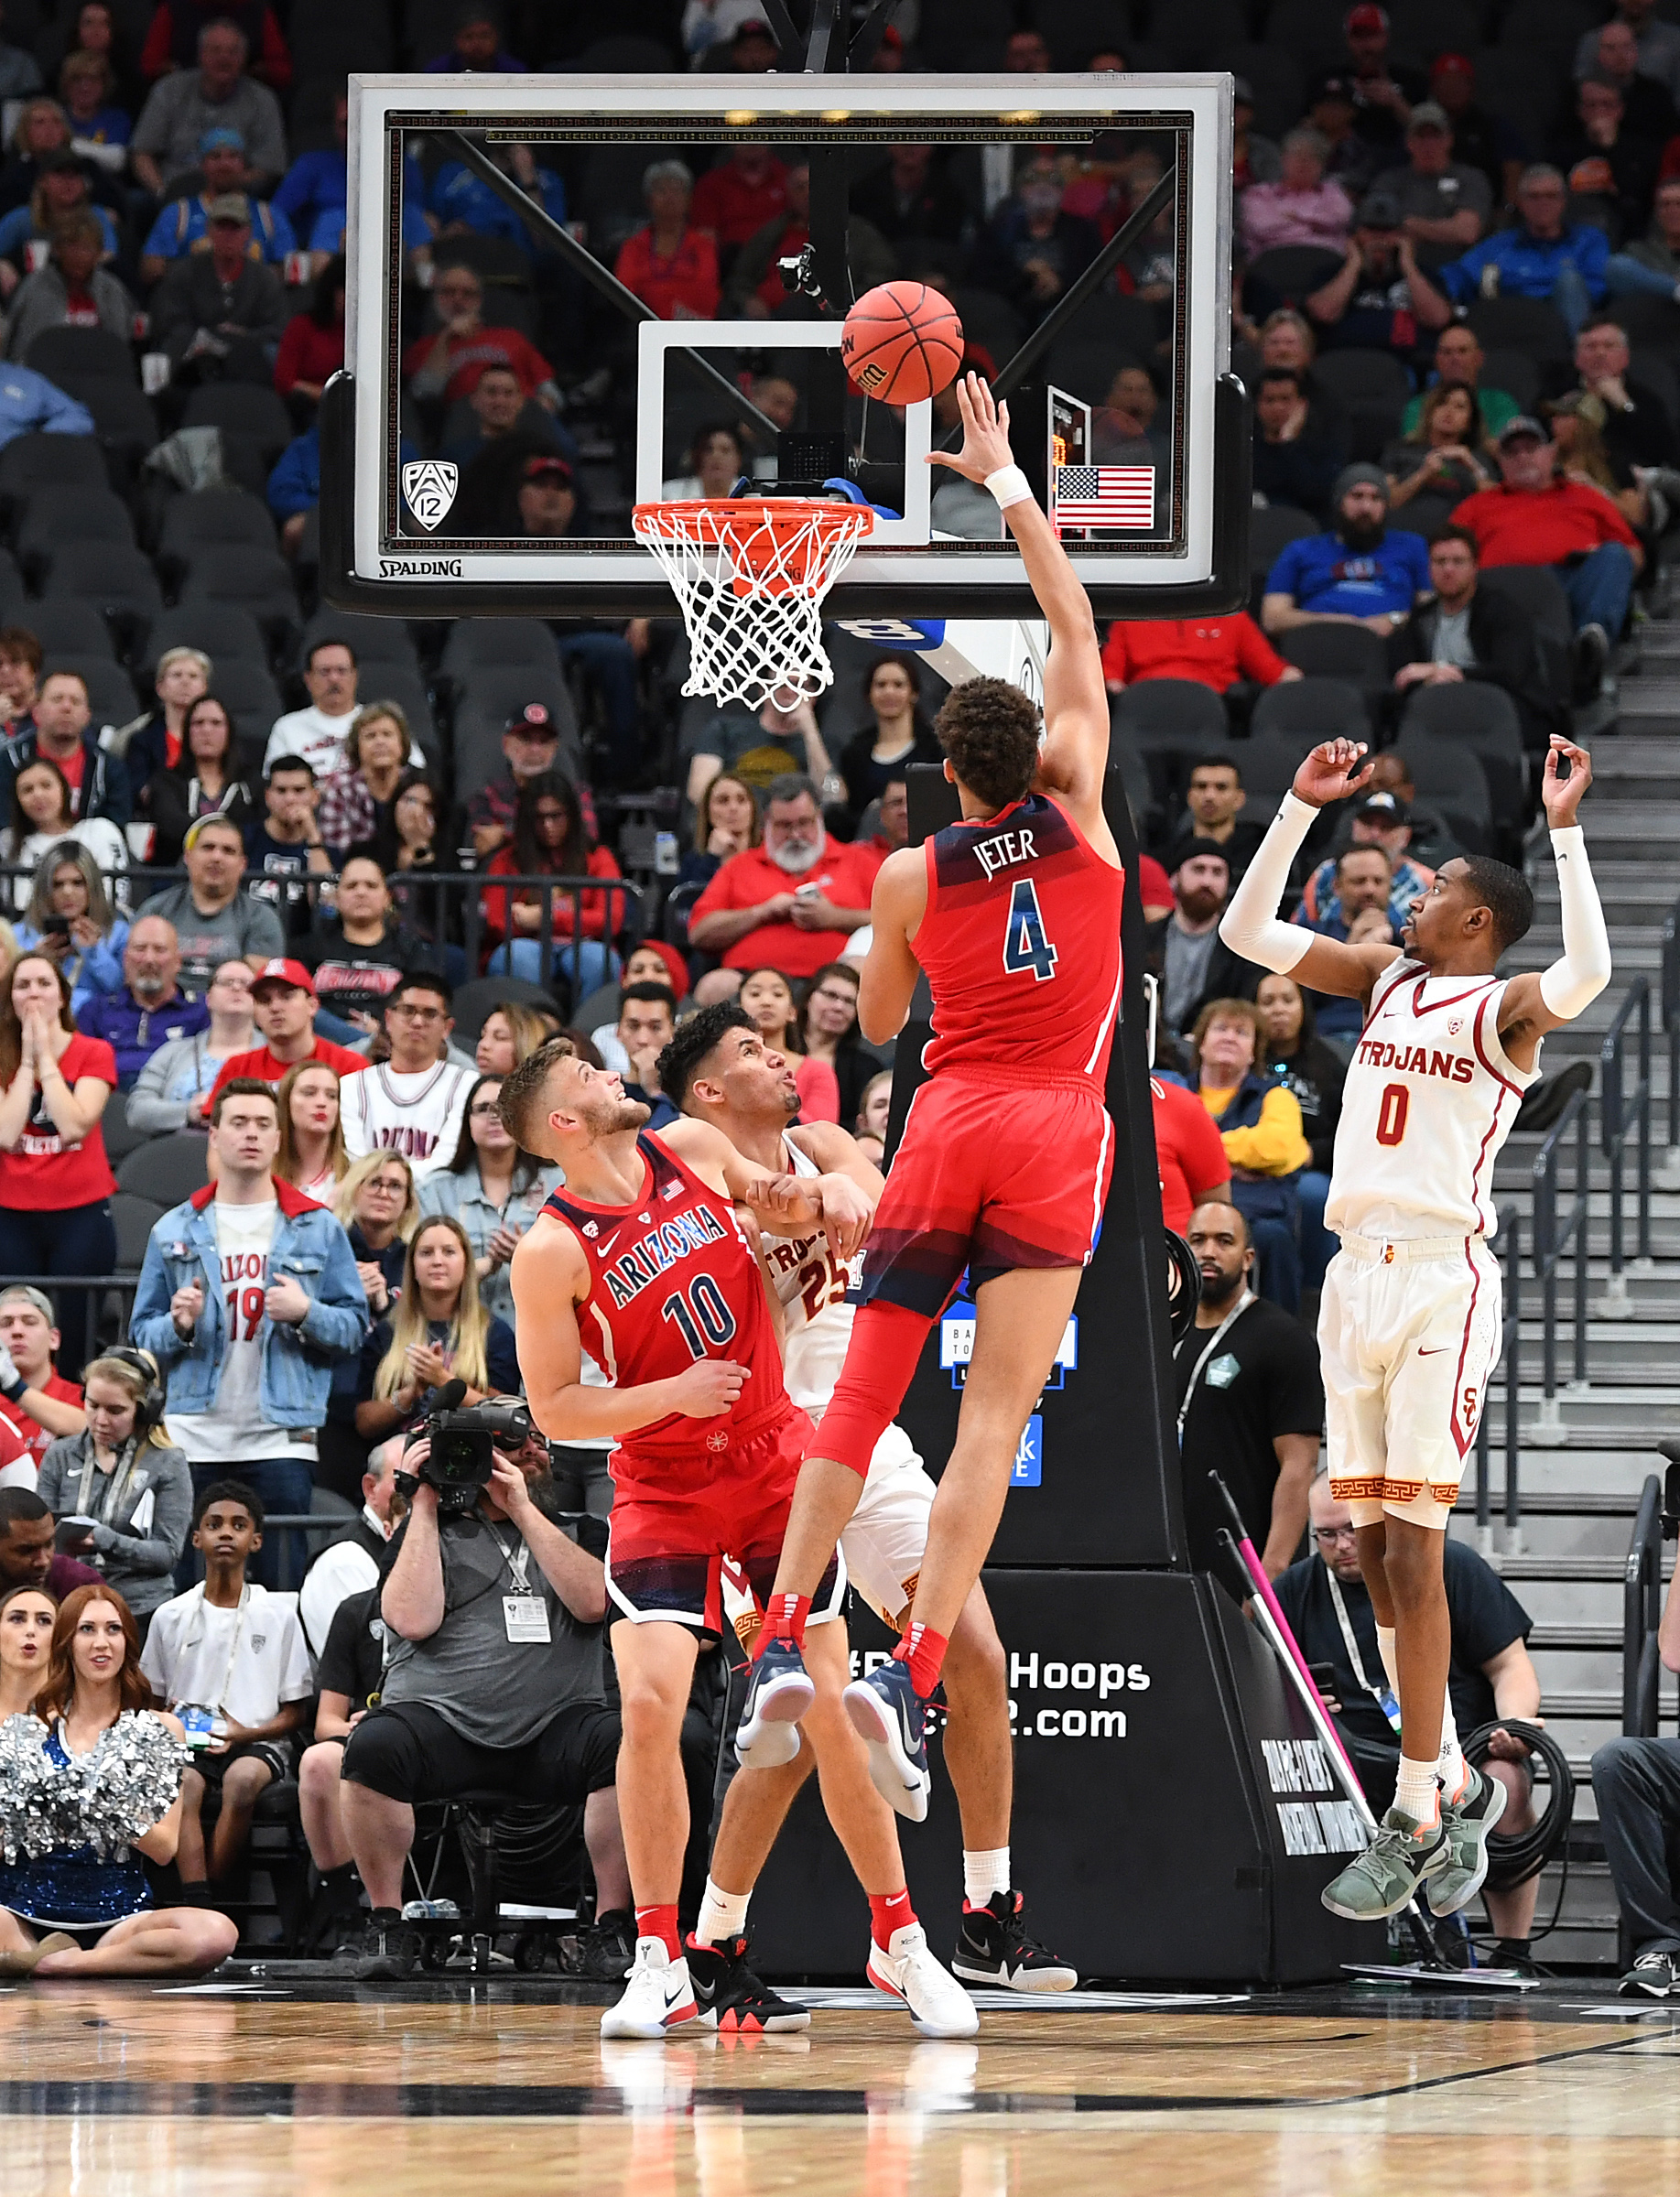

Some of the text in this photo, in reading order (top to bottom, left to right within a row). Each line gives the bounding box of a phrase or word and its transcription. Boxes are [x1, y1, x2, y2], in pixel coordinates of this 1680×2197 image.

[406, 463, 457, 502] PAC
[420, 498, 441, 517] 12
[379, 559, 461, 579] SPALDING
[972, 828, 1039, 882] JETER
[1003, 878, 1058, 981] 4
[1359, 1041, 1475, 1084] TROJANS
[1376, 1083, 1410, 1147] 0
[602, 1205, 728, 1310] ARIZONA
[798, 1250, 850, 1321] 25
[226, 1287, 266, 1342] 19
[661, 1273, 736, 1361] 10
